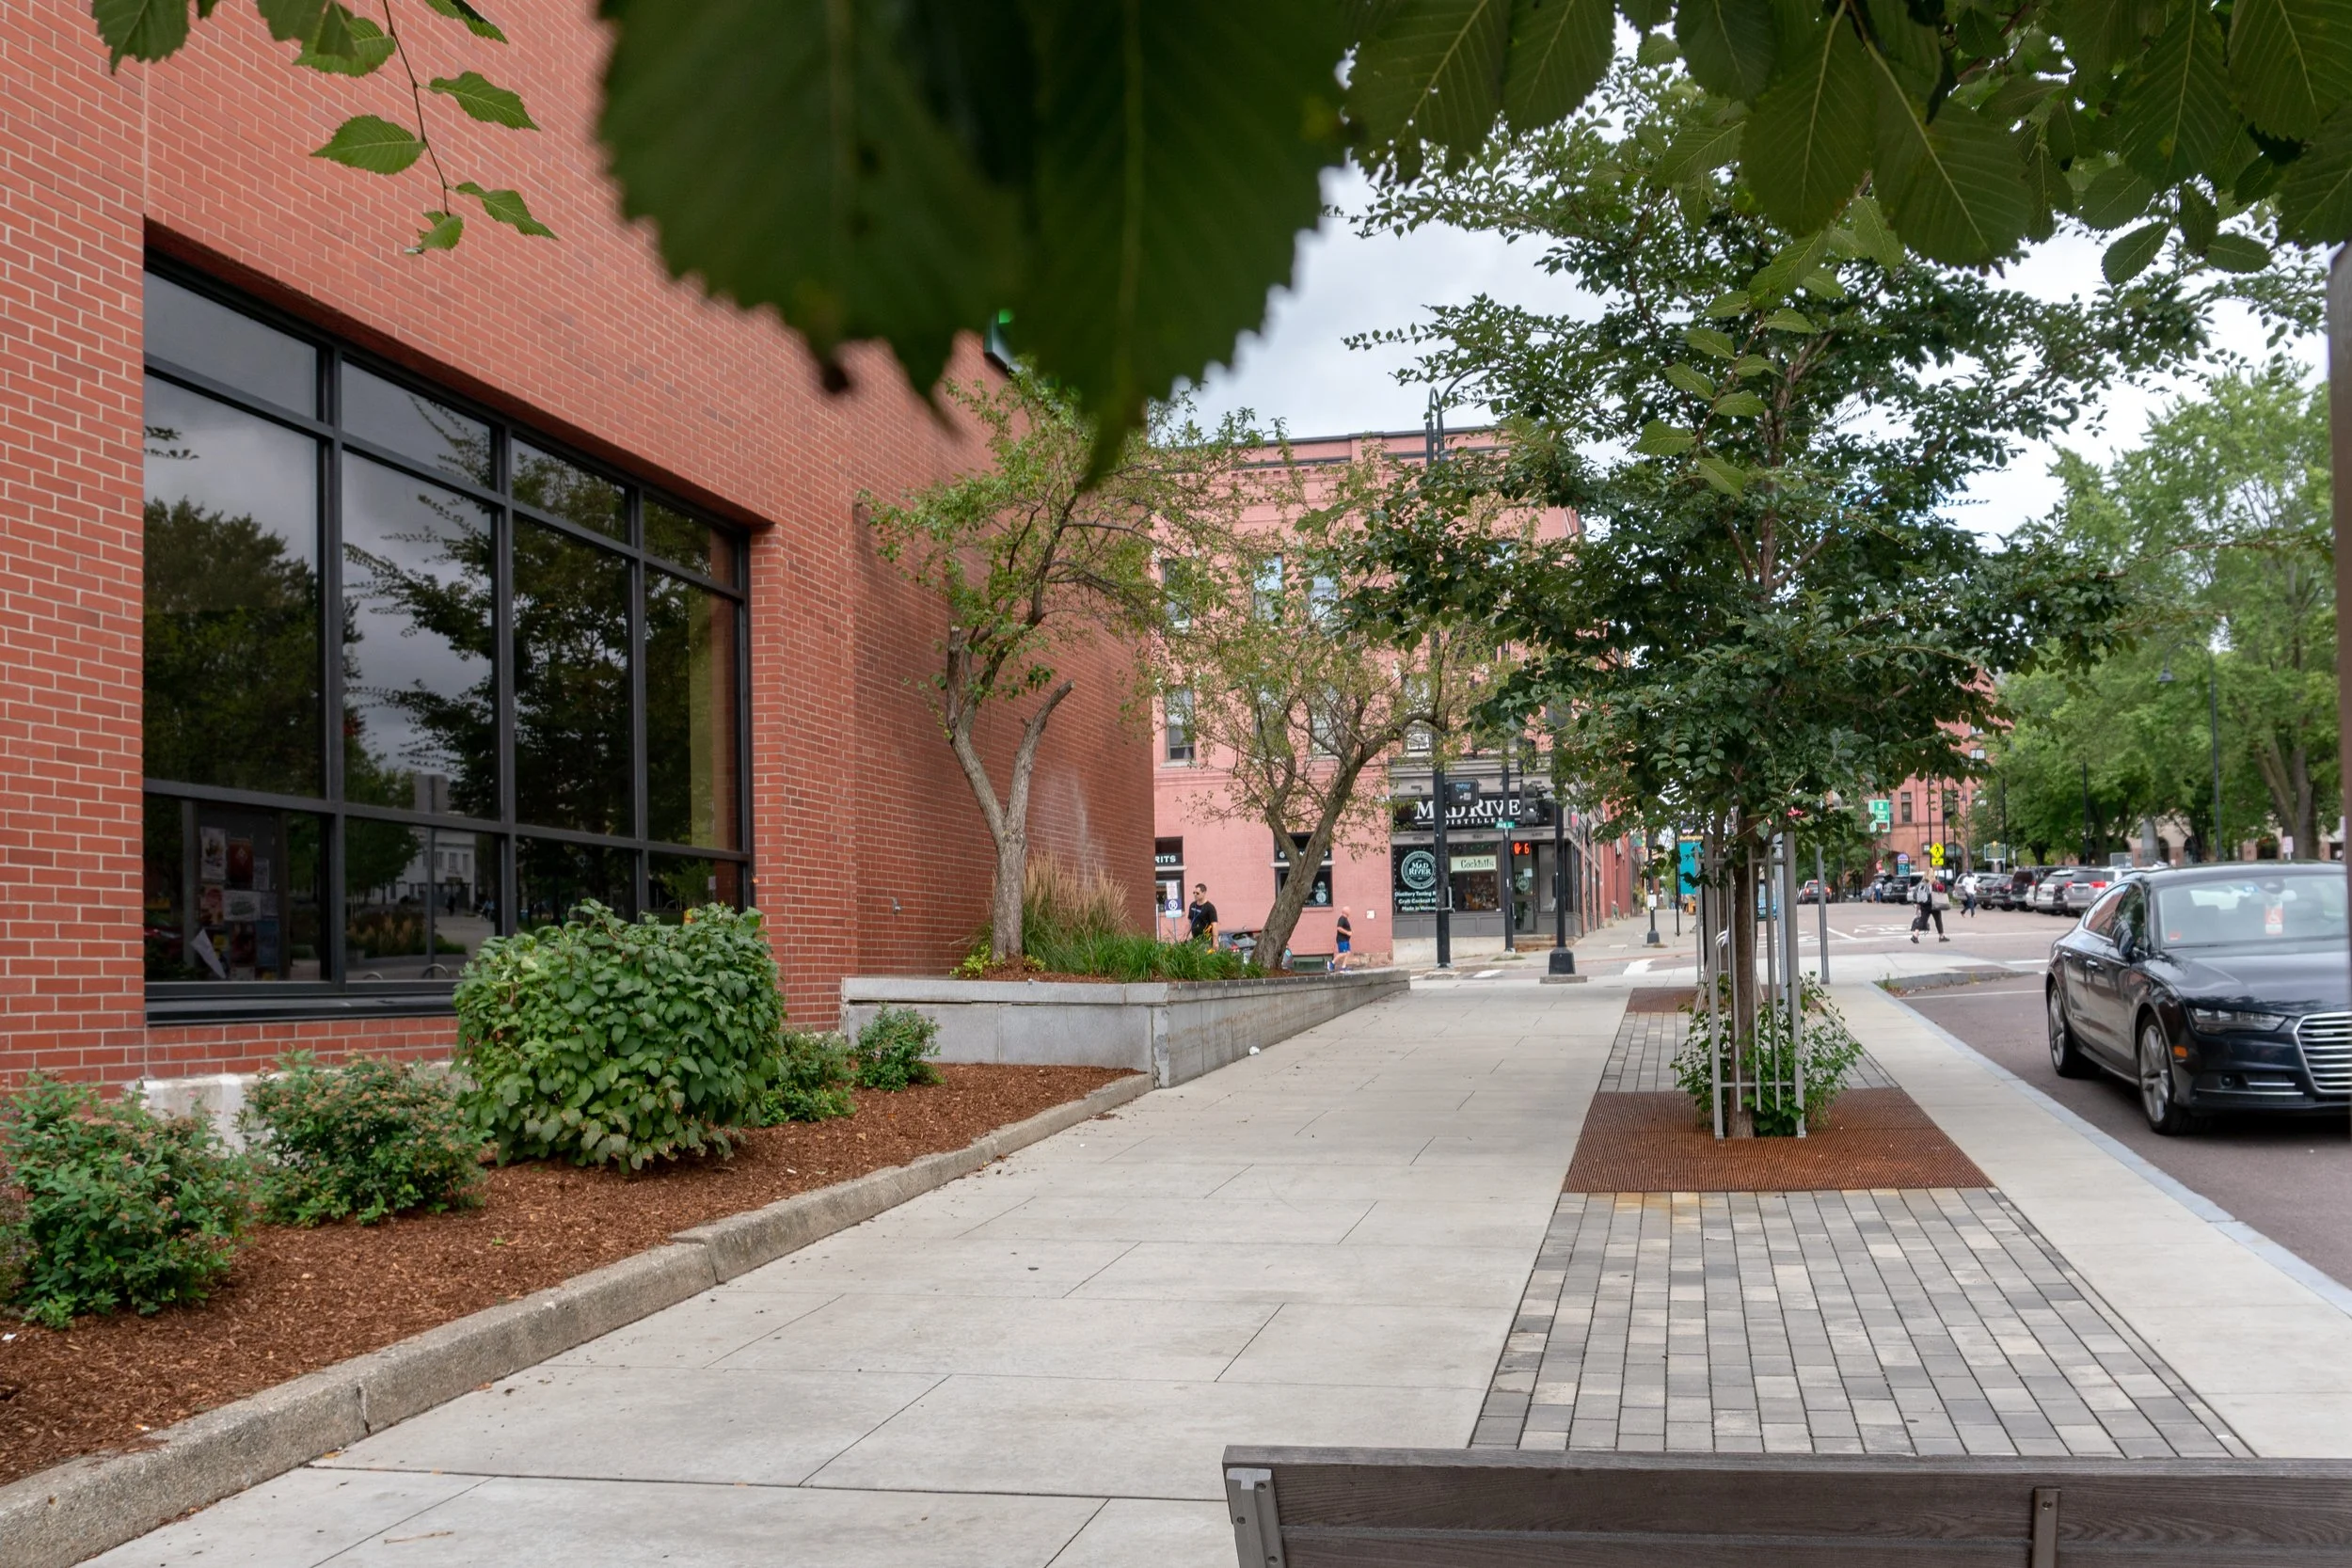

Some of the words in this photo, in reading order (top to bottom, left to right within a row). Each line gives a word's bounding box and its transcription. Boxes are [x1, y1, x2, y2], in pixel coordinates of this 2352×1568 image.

[1414, 799, 1469, 819] MD
[1469, 798, 1520, 817] RIVE
[1446, 816, 1503, 825] ISTILLER
[1524, 842, 1530, 854] 6
